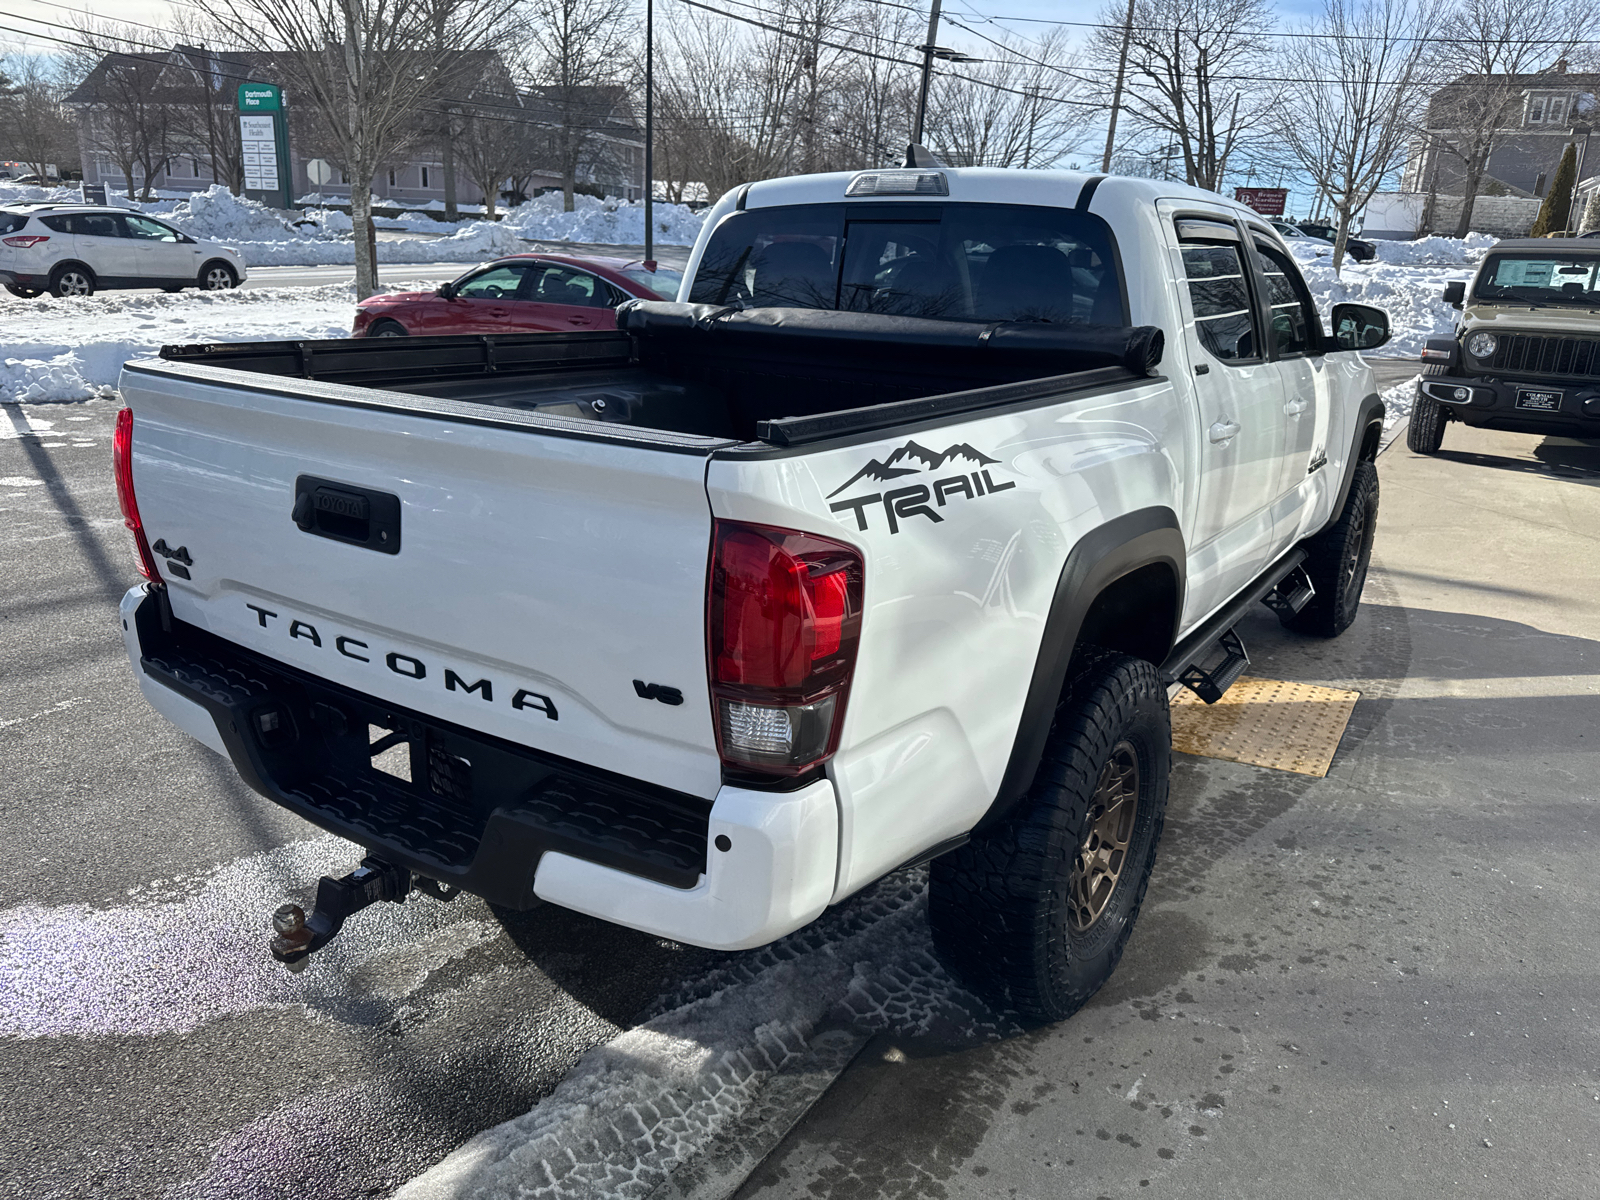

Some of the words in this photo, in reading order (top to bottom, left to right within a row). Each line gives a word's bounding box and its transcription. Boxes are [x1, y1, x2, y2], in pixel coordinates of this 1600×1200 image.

[316, 494, 360, 516] TOYOTA
[829, 470, 1016, 535] TRAIL
[246, 603, 559, 721] TACOMA
[632, 679, 684, 706] V6
